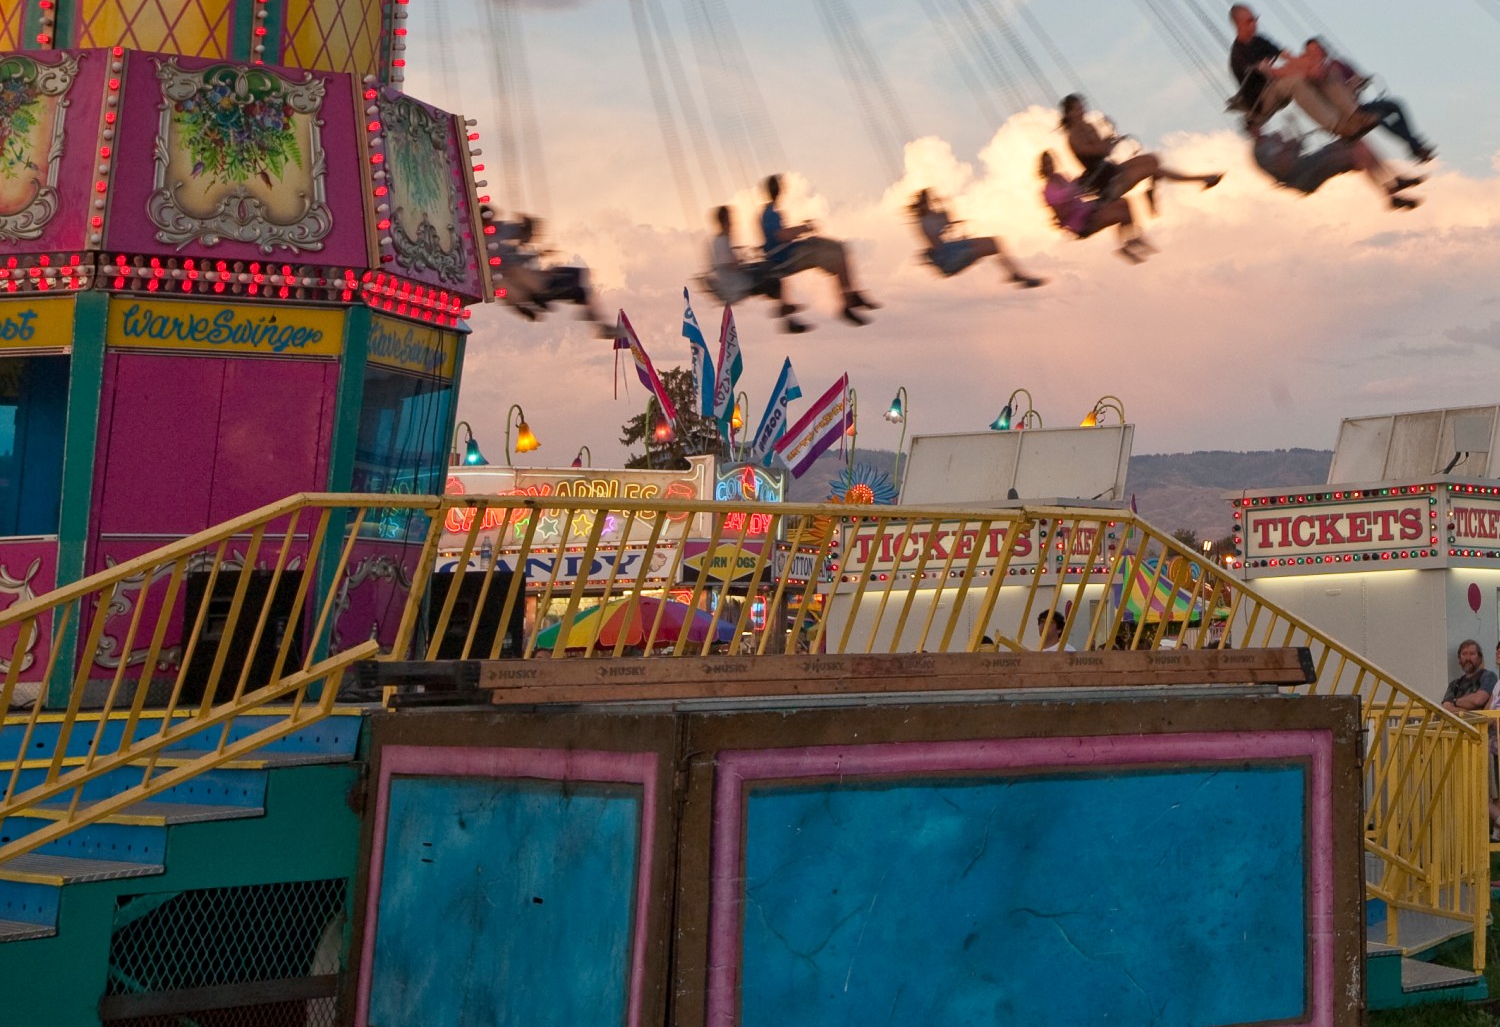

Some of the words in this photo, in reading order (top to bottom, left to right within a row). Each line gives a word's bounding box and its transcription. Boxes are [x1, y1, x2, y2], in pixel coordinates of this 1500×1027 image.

[1253, 508, 1423, 549] TICKETS
[854, 525, 1032, 563] TICKETS
[730, 556, 756, 568] OGS
[787, 554, 814, 577] OTTON
[992, 658, 1022, 668] HUSKY
[1075, 657, 1104, 666] HUSKY
[1155, 656, 1182, 665] HUSKY
[610, 666, 646, 676] HUSKY
[713, 664, 748, 673] HUSKY
[500, 670, 537, 679] HUSKY
